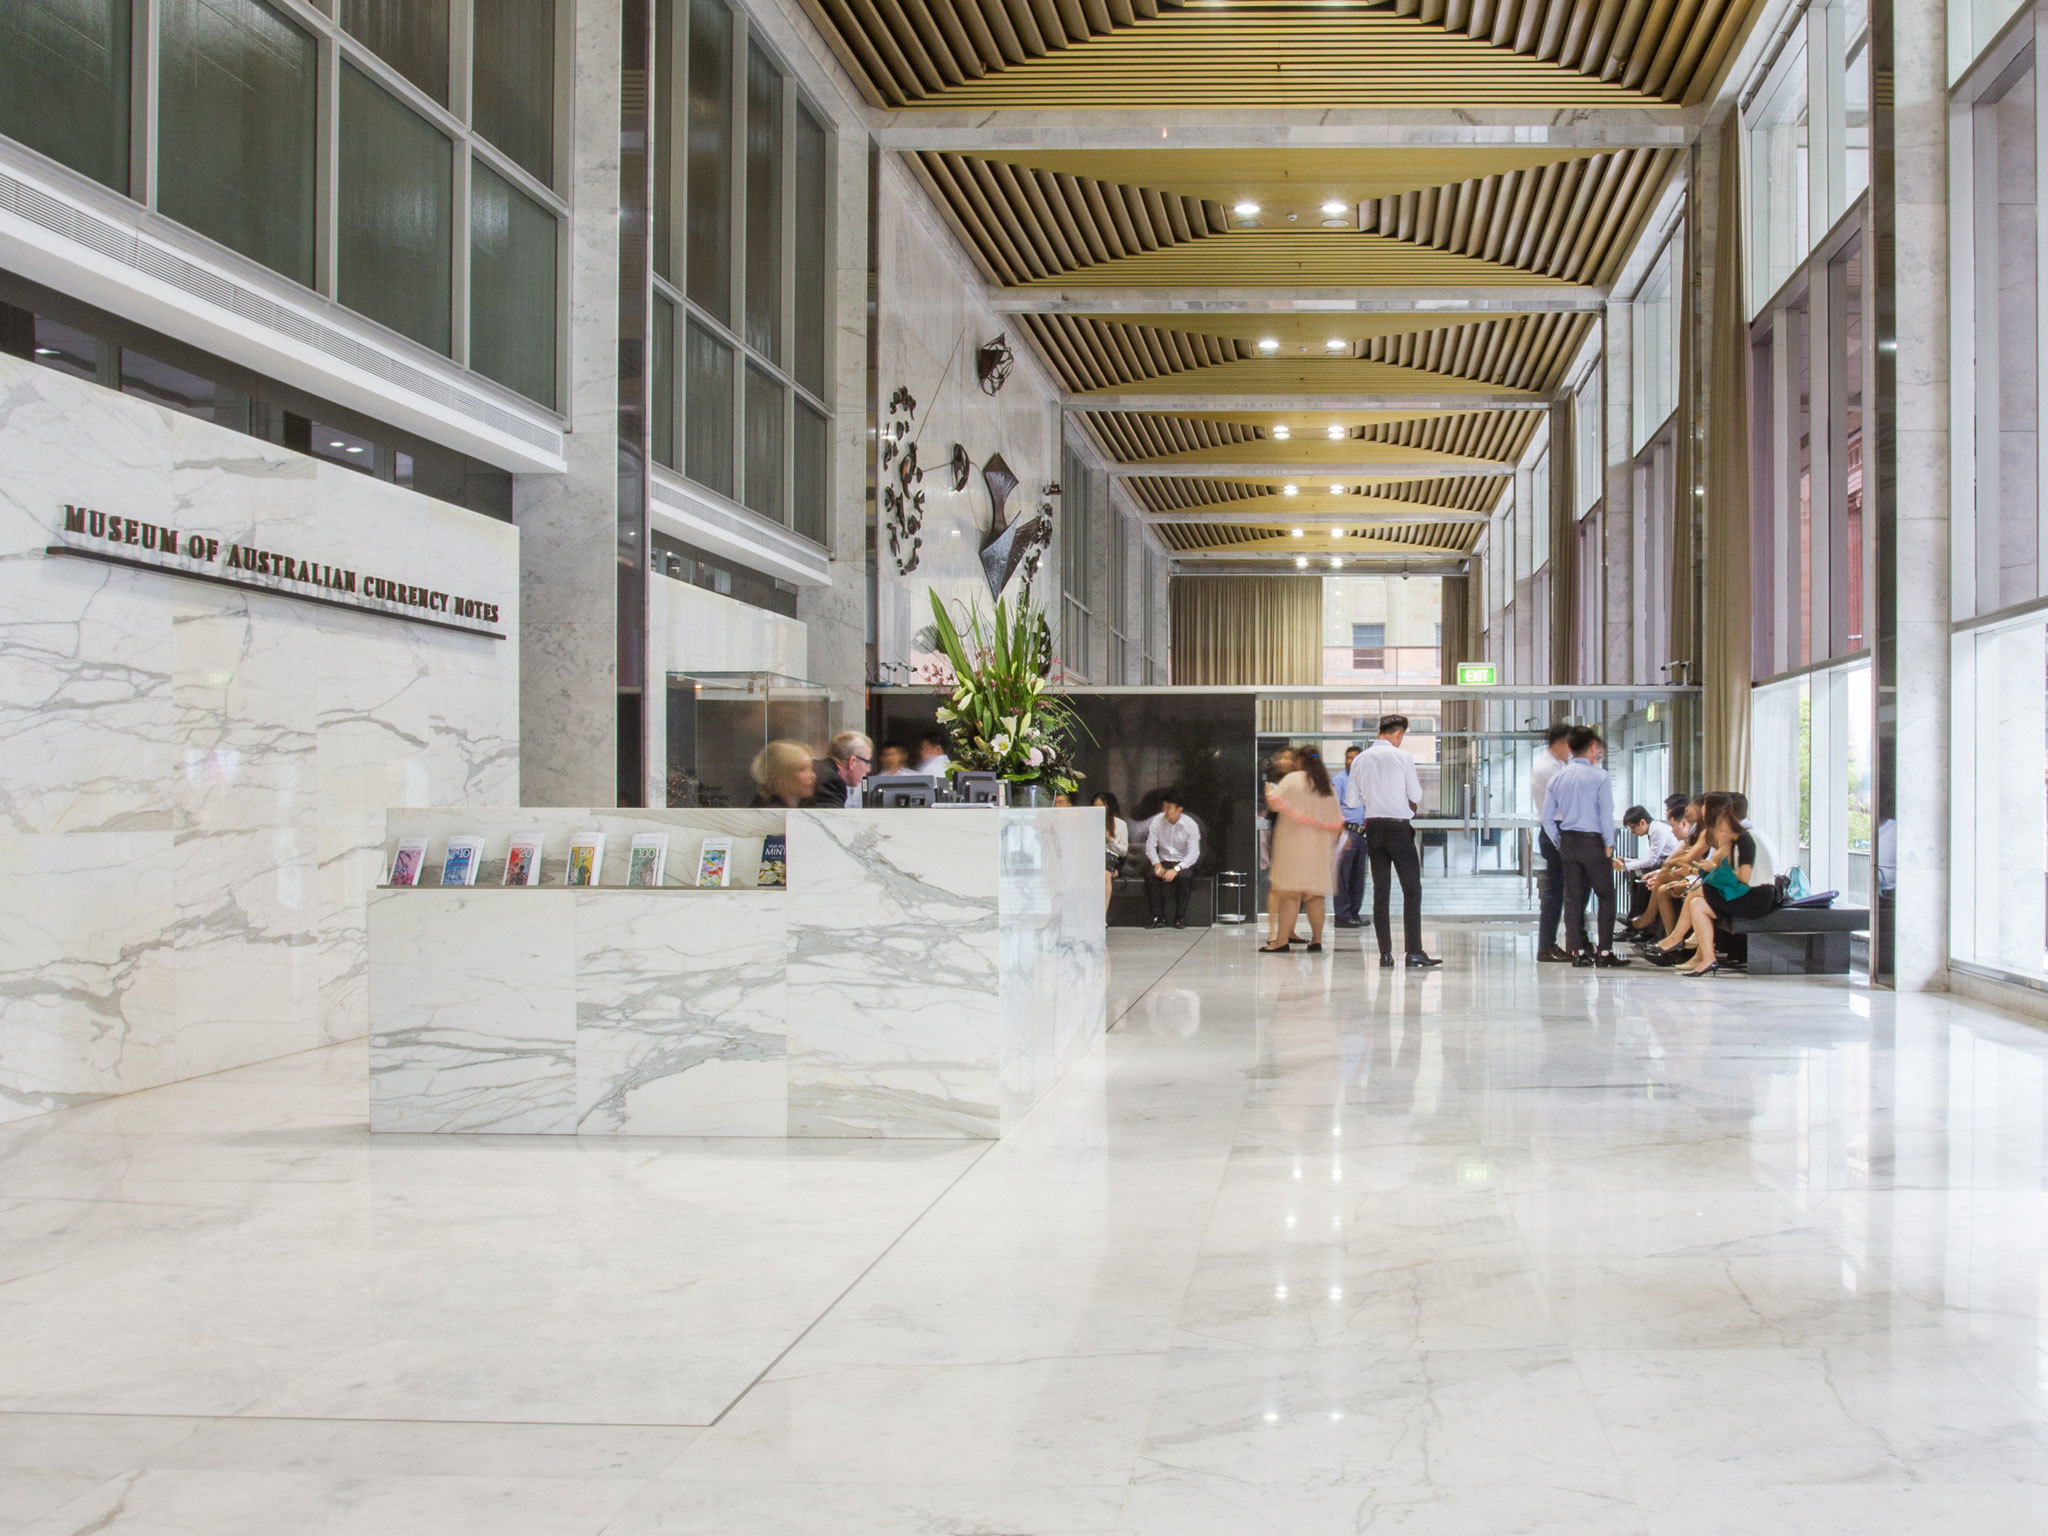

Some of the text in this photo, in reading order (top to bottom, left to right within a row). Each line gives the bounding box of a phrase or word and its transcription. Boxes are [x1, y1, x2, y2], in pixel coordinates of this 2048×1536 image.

[64, 504, 499, 623] MUSEUM OF AUSTRALIAN CURRENCY NOTES
[1465, 669, 1488, 682] EXIT
[460, 849, 470, 858] 10
[519, 847, 533, 858] 20
[580, 847, 594, 857] 50
[636, 848, 656, 859] 100
